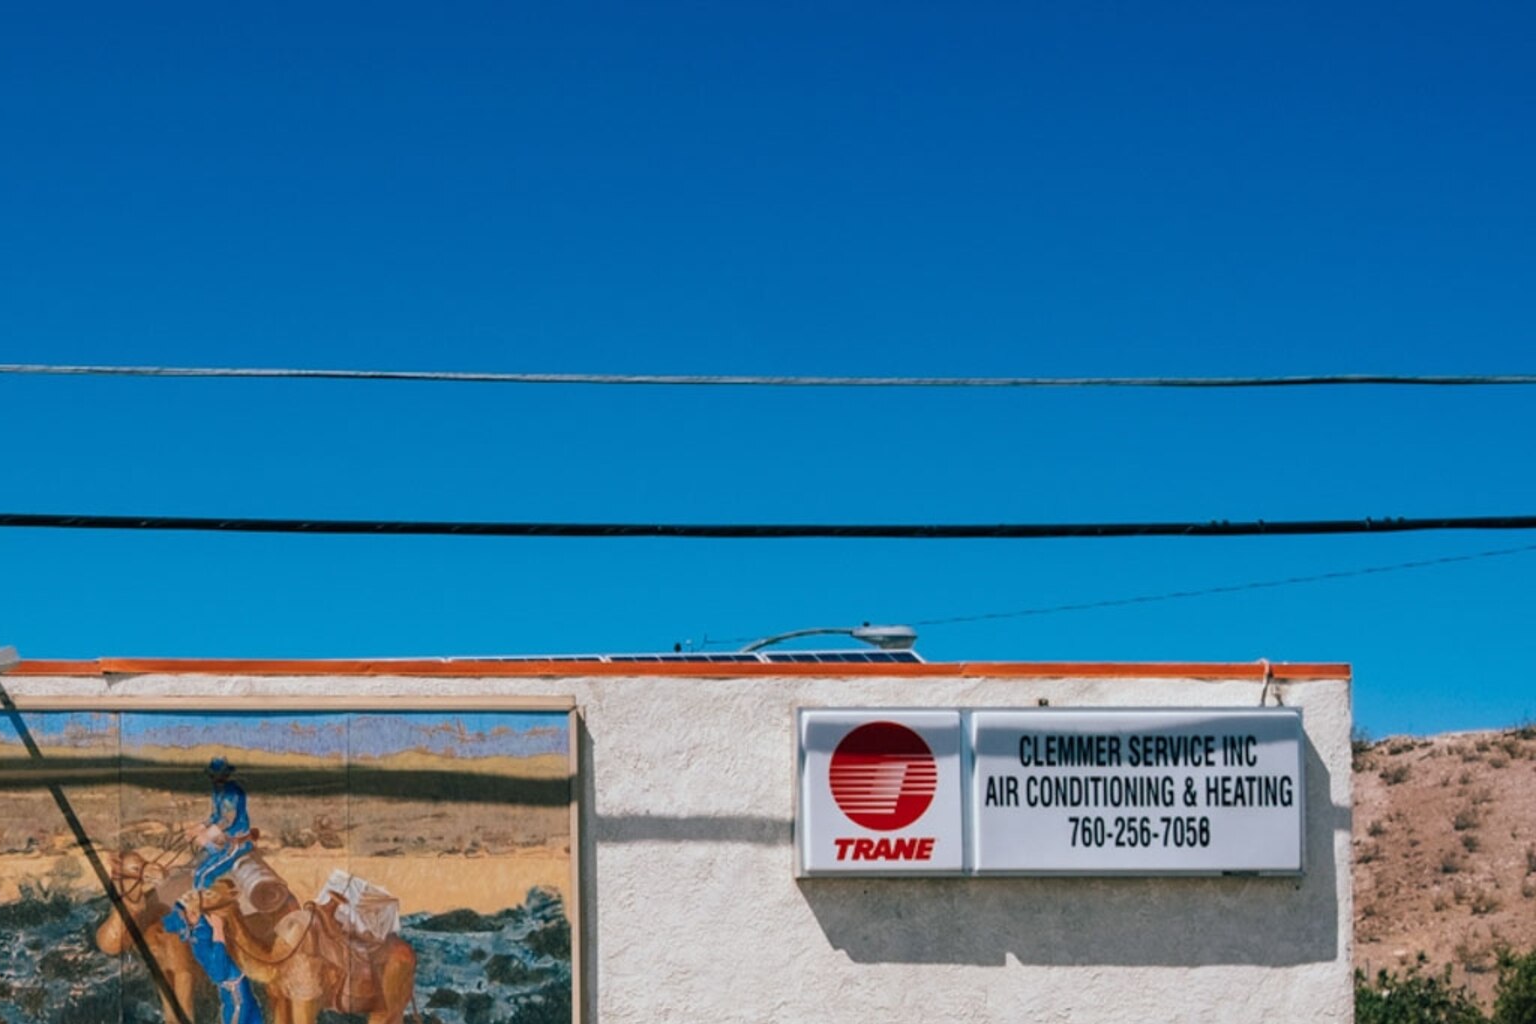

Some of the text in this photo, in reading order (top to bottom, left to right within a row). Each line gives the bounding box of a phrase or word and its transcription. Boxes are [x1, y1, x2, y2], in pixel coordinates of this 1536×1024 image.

[1019, 735, 1257, 767] CLEMMER SERVICE INC
[985, 776, 1293, 807] AIR CONDITIONING & HEATING
[1068, 816, 1210, 847] 760-256-7058
[834, 837, 935, 862] TRANE
